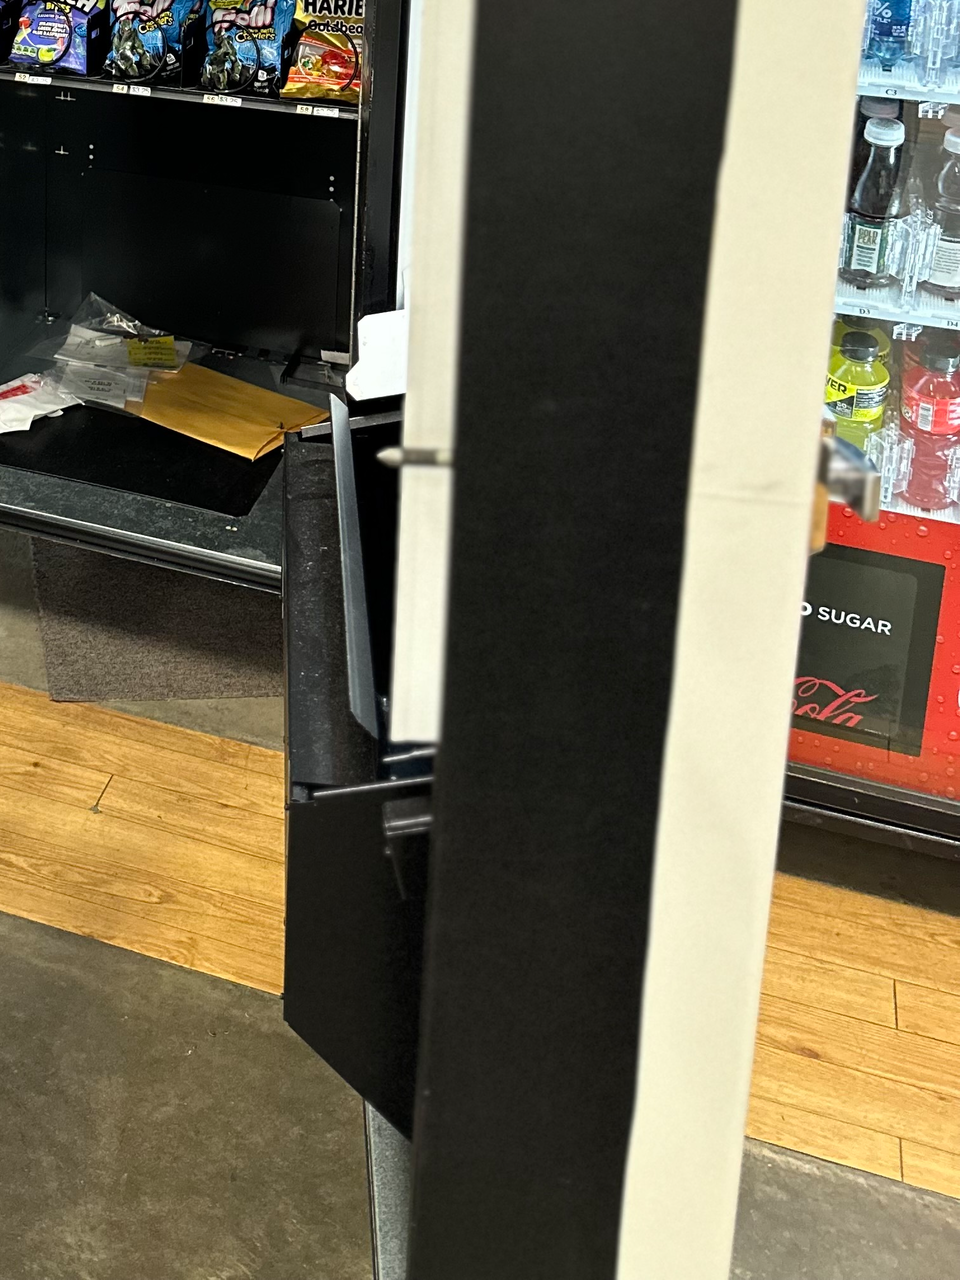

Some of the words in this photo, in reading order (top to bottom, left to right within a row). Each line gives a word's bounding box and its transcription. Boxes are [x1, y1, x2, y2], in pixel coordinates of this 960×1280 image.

[885, 87, 898, 96] C3
[858, 307, 871, 315] D3
[946, 320, 959, 328] D4
[816, 605, 893, 636] SUGAR
